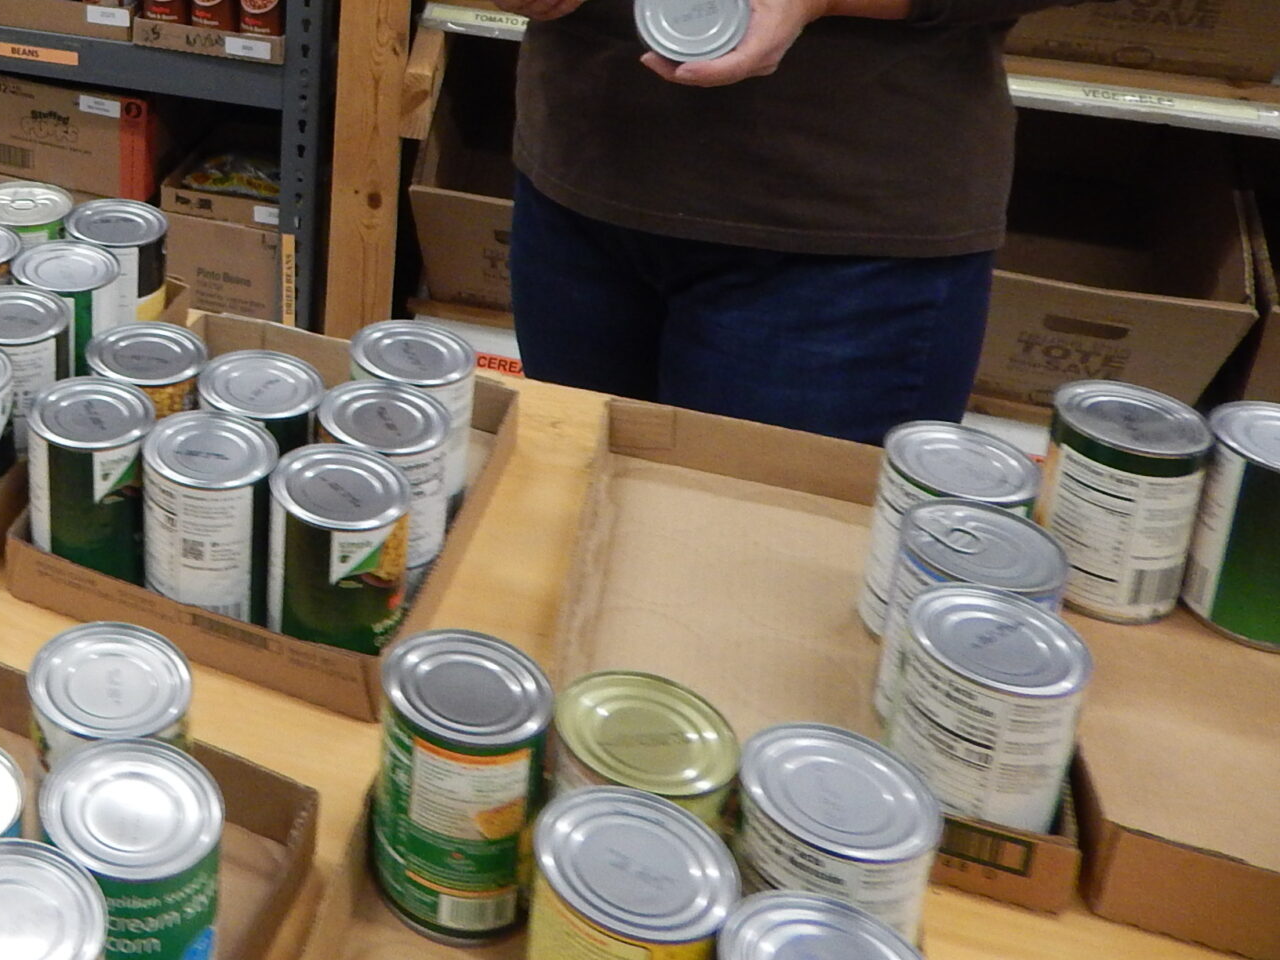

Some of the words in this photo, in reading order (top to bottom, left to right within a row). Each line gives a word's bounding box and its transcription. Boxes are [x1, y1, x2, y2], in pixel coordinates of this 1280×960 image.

[474, 12, 518, 26] TOMATO
[10, 46, 40, 58] BEANS
[30, 109, 70, 125] Stuffed
[197, 267, 219, 280] Pinto
[222, 271, 252, 287] Beans
[285, 254, 293, 284] BEANS
[285, 286, 293, 315] DRIED
[476, 355, 524, 374] CERE
[104, 935, 161, 955] corn
